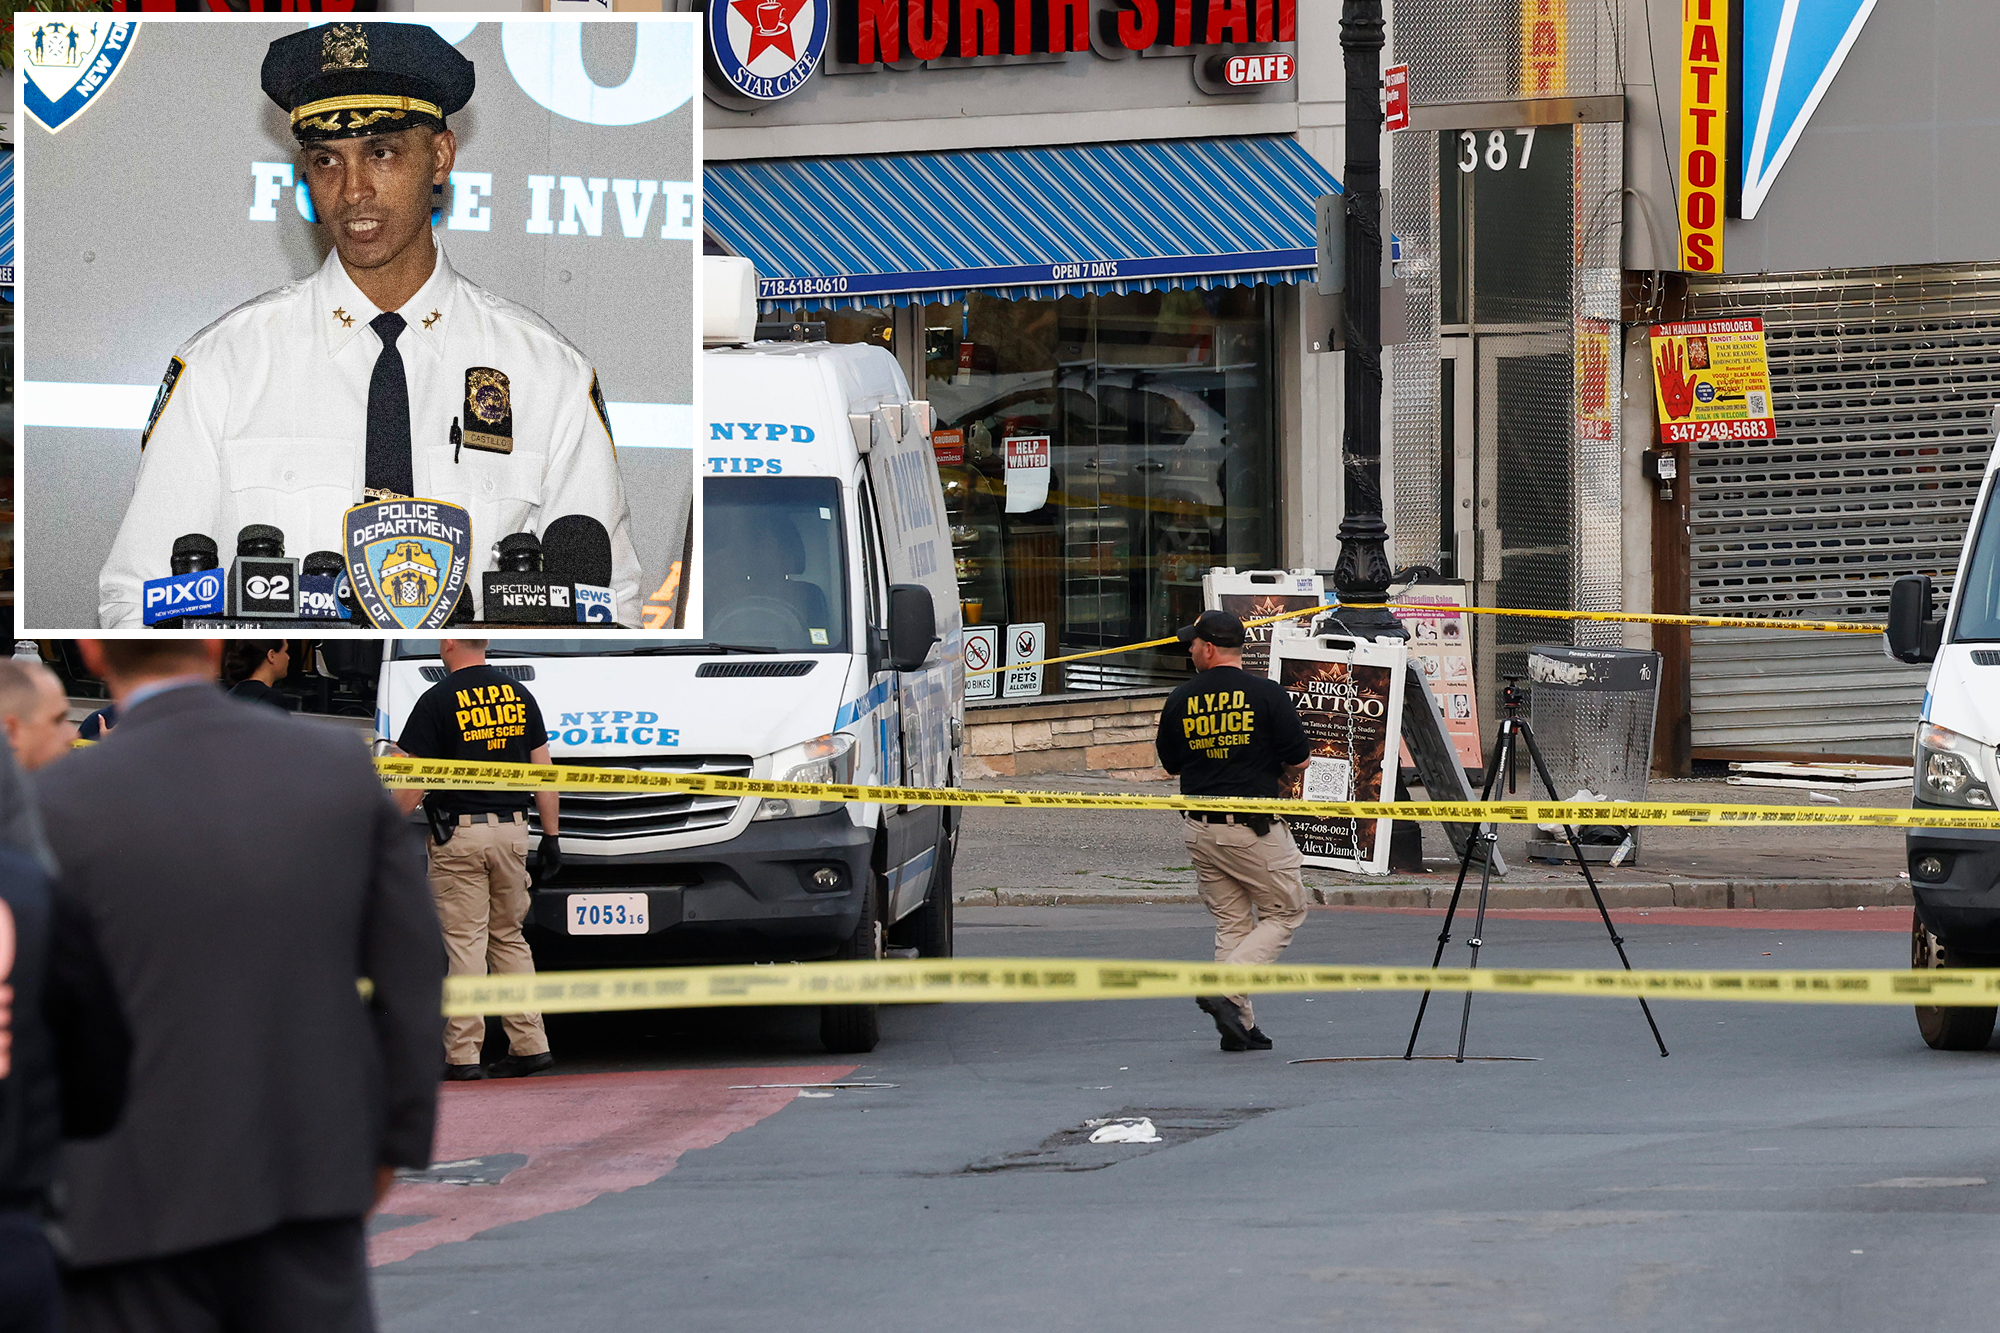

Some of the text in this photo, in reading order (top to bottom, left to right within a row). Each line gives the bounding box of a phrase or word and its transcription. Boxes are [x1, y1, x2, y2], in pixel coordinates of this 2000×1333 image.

[76, 54, 113, 98] NEW
[734, 51, 816, 96] STAR CAFE
[1230, 56, 1288, 82] CAFE
[1458, 128, 1536, 173] 387
[1052, 262, 1118, 279] OPEN 7 DAYS
[761, 278, 848, 296] 718-618-0610
[1673, 322, 1707, 335] HANUMAN
[1708, 321, 1753, 333] ASTROLOGER
[710, 422, 815, 444] NYPD
[1670, 421, 1767, 440] 347-249-5683
[471, 434, 507, 447] CASTILLO
[1016, 441, 1039, 454] HELP
[703, 458, 783, 474] TIPS
[936, 454, 961, 462] eamless
[1009, 454, 1046, 468] WANTED
[378, 504, 438, 520] POLICE
[354, 518, 463, 547] DEPARTMENT
[147, 581, 196, 609] PIX
[270, 576, 289, 599] 2
[354, 562, 391, 623] CITY OF
[428, 556, 466, 628] NEW YORK
[490, 584, 546, 594] SPECTRUM
[300, 591, 334, 610] FOX
[503, 594, 546, 606] NEWS
[973, 680, 990, 689] BIKES
[1011, 672, 1037, 683] PETS
[455, 684, 521, 707] N.Y.P.D.
[1308, 681, 1358, 697] ERIKON
[1187, 690, 1250, 715] N.Y.P.D.
[1286, 691, 1384, 718] TATTOO
[456, 703, 527, 728] POLICE
[559, 710, 658, 726] NYPD
[1182, 711, 1254, 738] POLICE
[1334, 723, 1356, 732] Piercg
[463, 724, 525, 742] CRIME SCENE
[547, 726, 680, 747] POLICE
[487, 738, 506, 751] UNIT
[1188, 734, 1250, 750] CRIME SCENE
[1206, 748, 1229, 759] UNIT
[1415, 808, 1432, 816] CRIME
[1538, 808, 1553, 818] CROSS
[1555, 808, 1565, 818] NOT
[1566, 808, 1572, 818] DO
[1578, 808, 1593, 818] SCENE
[1594, 808, 1610, 818] CRIME
[1611, 807, 1628, 819] (8477)
[1628, 809, 1667, 819] 1-800-577-TIPS
[1719, 812, 1737, 821] CROSS
[1737, 812, 1748, 821] NOT
[1760, 812, 1778, 821] SCENE
[1778, 812, 1796, 821] CRIME
[1294, 822, 1348, 836] 347-608-0021
[1302, 841, 1323, 853] Alex
[576, 905, 644, 925] 7053 16
